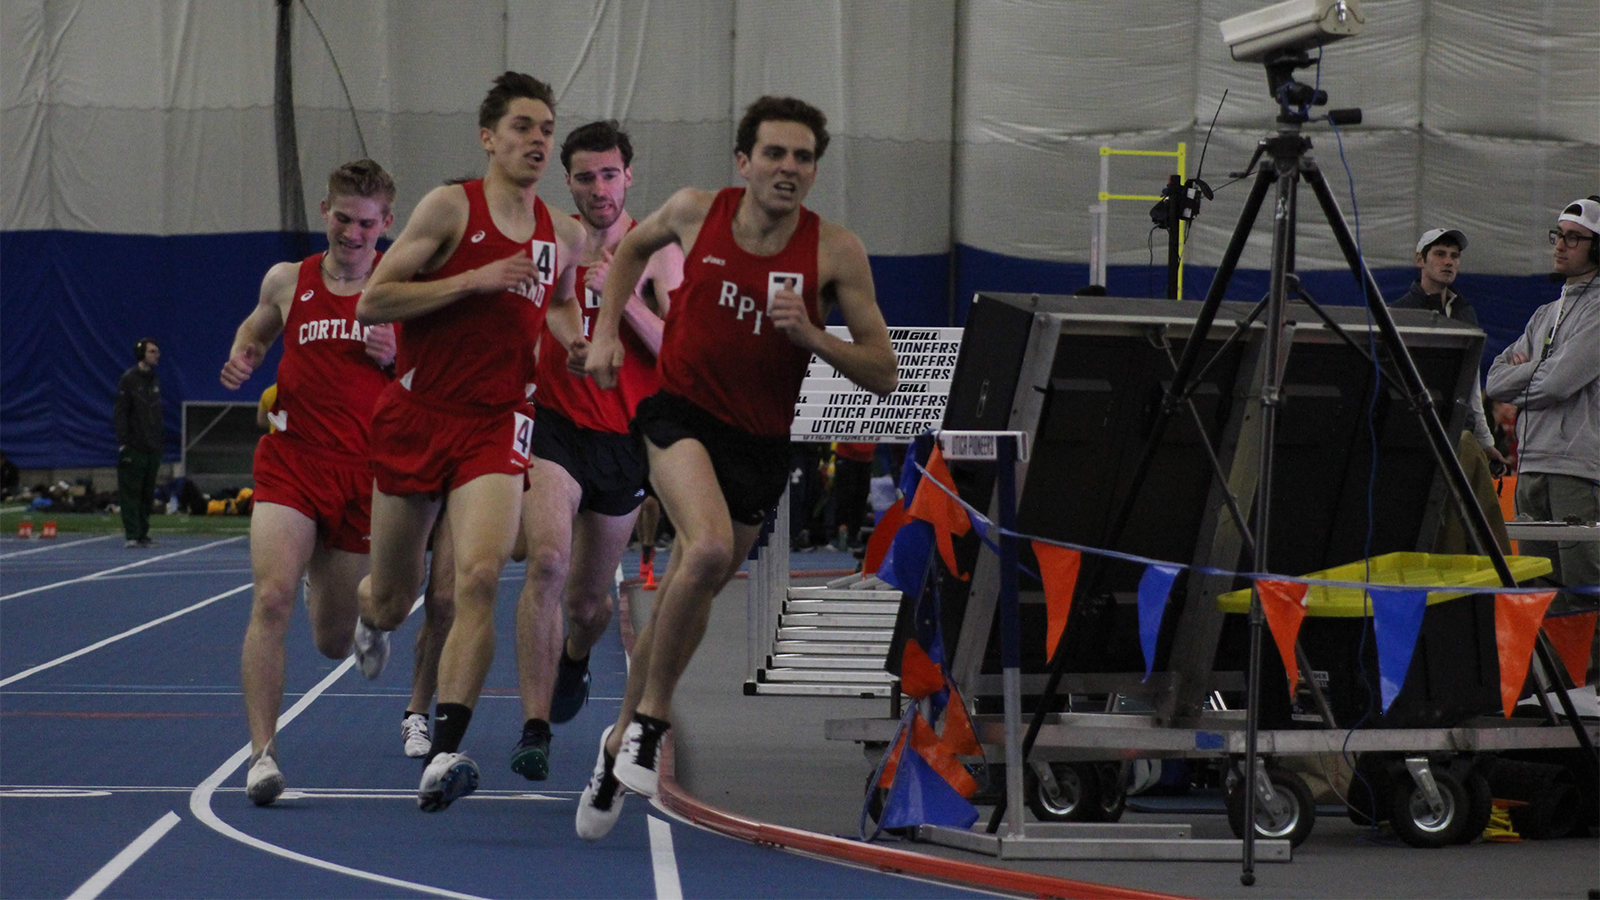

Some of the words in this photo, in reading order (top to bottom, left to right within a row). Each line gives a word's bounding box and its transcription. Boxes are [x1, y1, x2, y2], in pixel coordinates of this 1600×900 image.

[536, 244, 551, 280] 4
[718, 280, 763, 335] RPI
[909, 332, 938, 340] GILL
[897, 355, 956, 366] IONEERS
[898, 383, 927, 393] GILL
[828, 394, 872, 405] UTICA
[822, 407, 866, 418] UTICA
[870, 407, 942, 419] PIONEERS
[811, 420, 856, 433] UTICA
[859, 421, 932, 434] PIONEERS
[516, 419, 530, 454] 4
